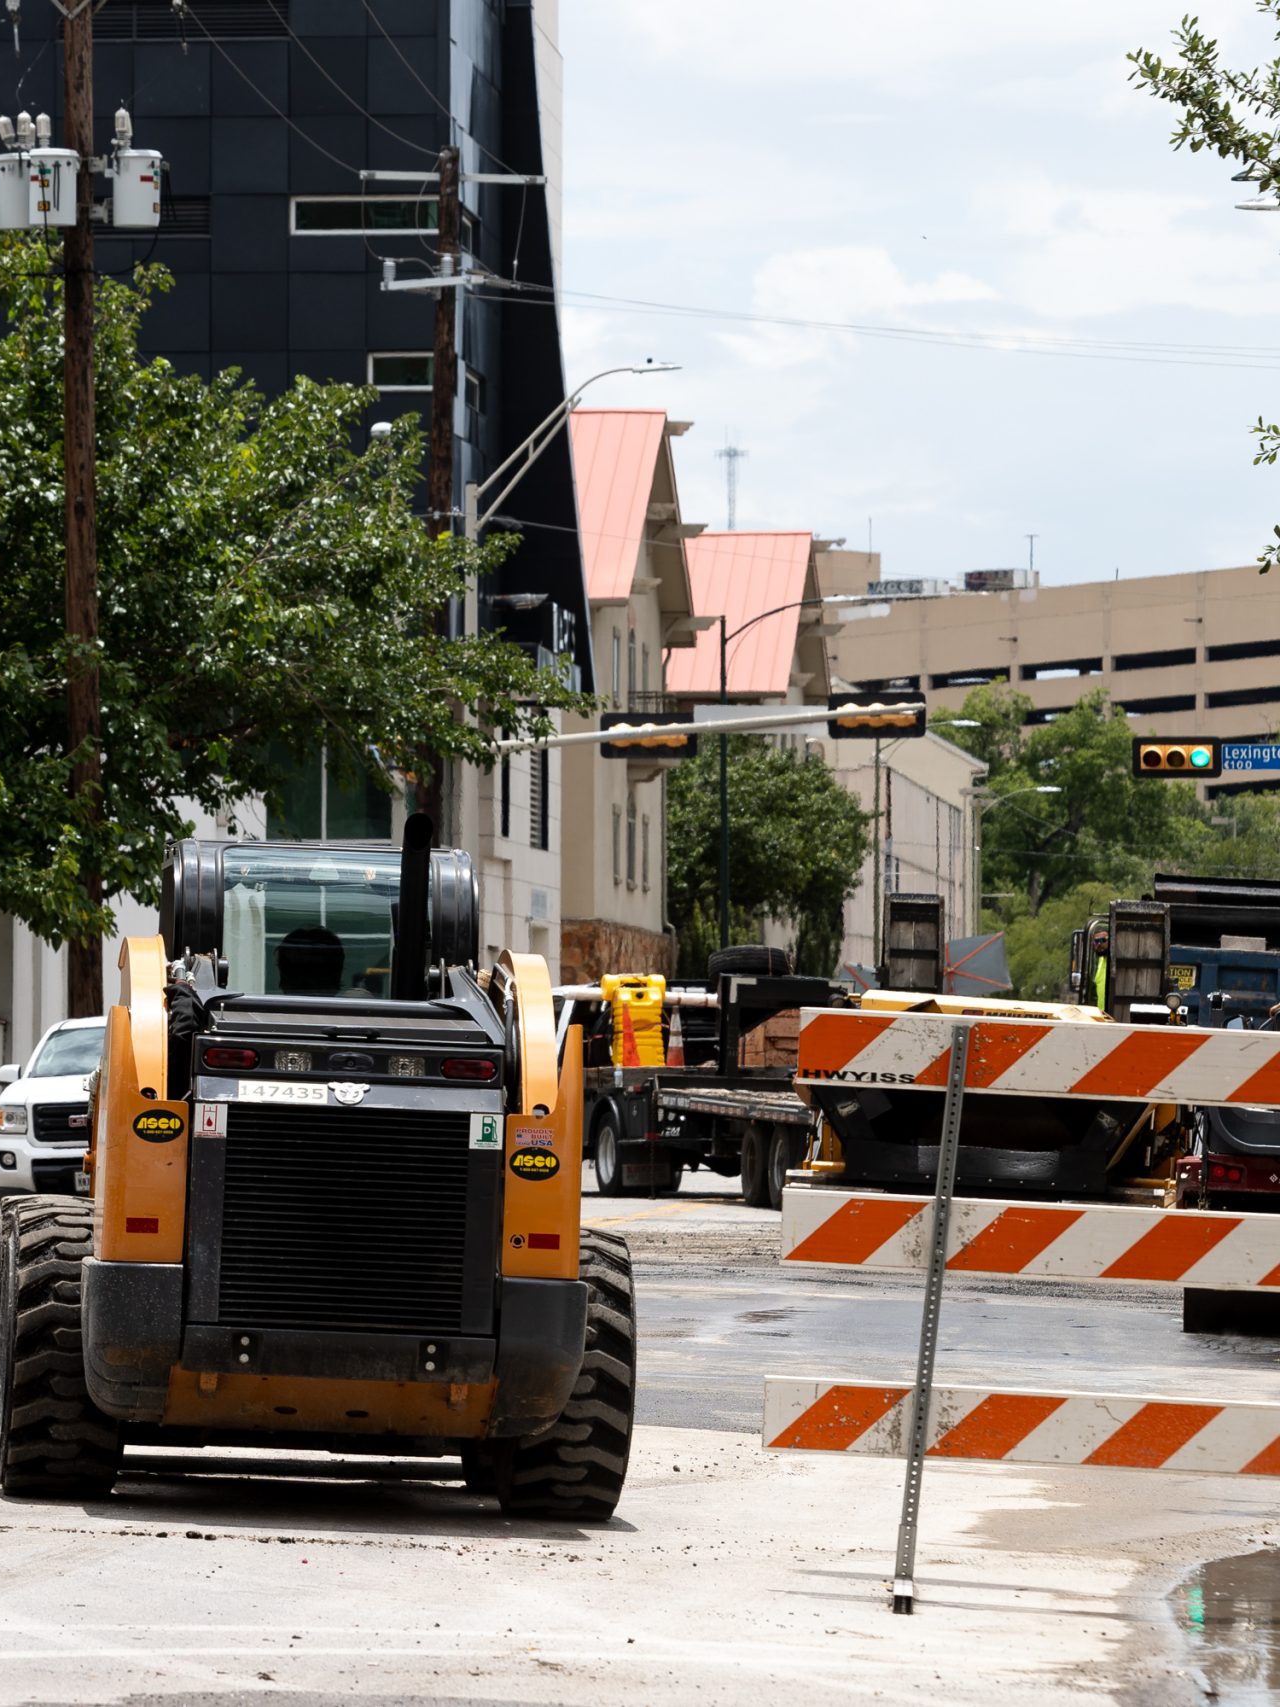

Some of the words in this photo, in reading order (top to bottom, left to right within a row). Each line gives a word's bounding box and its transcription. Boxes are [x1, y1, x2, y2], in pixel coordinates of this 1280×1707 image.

[1170, 967, 1191, 977] TION
[802, 1068, 915, 1084] HWYISS
[240, 1085, 324, 1100] 147435
[136, 1117, 181, 1130] ASCO
[513, 1154, 557, 1168] ASCO
